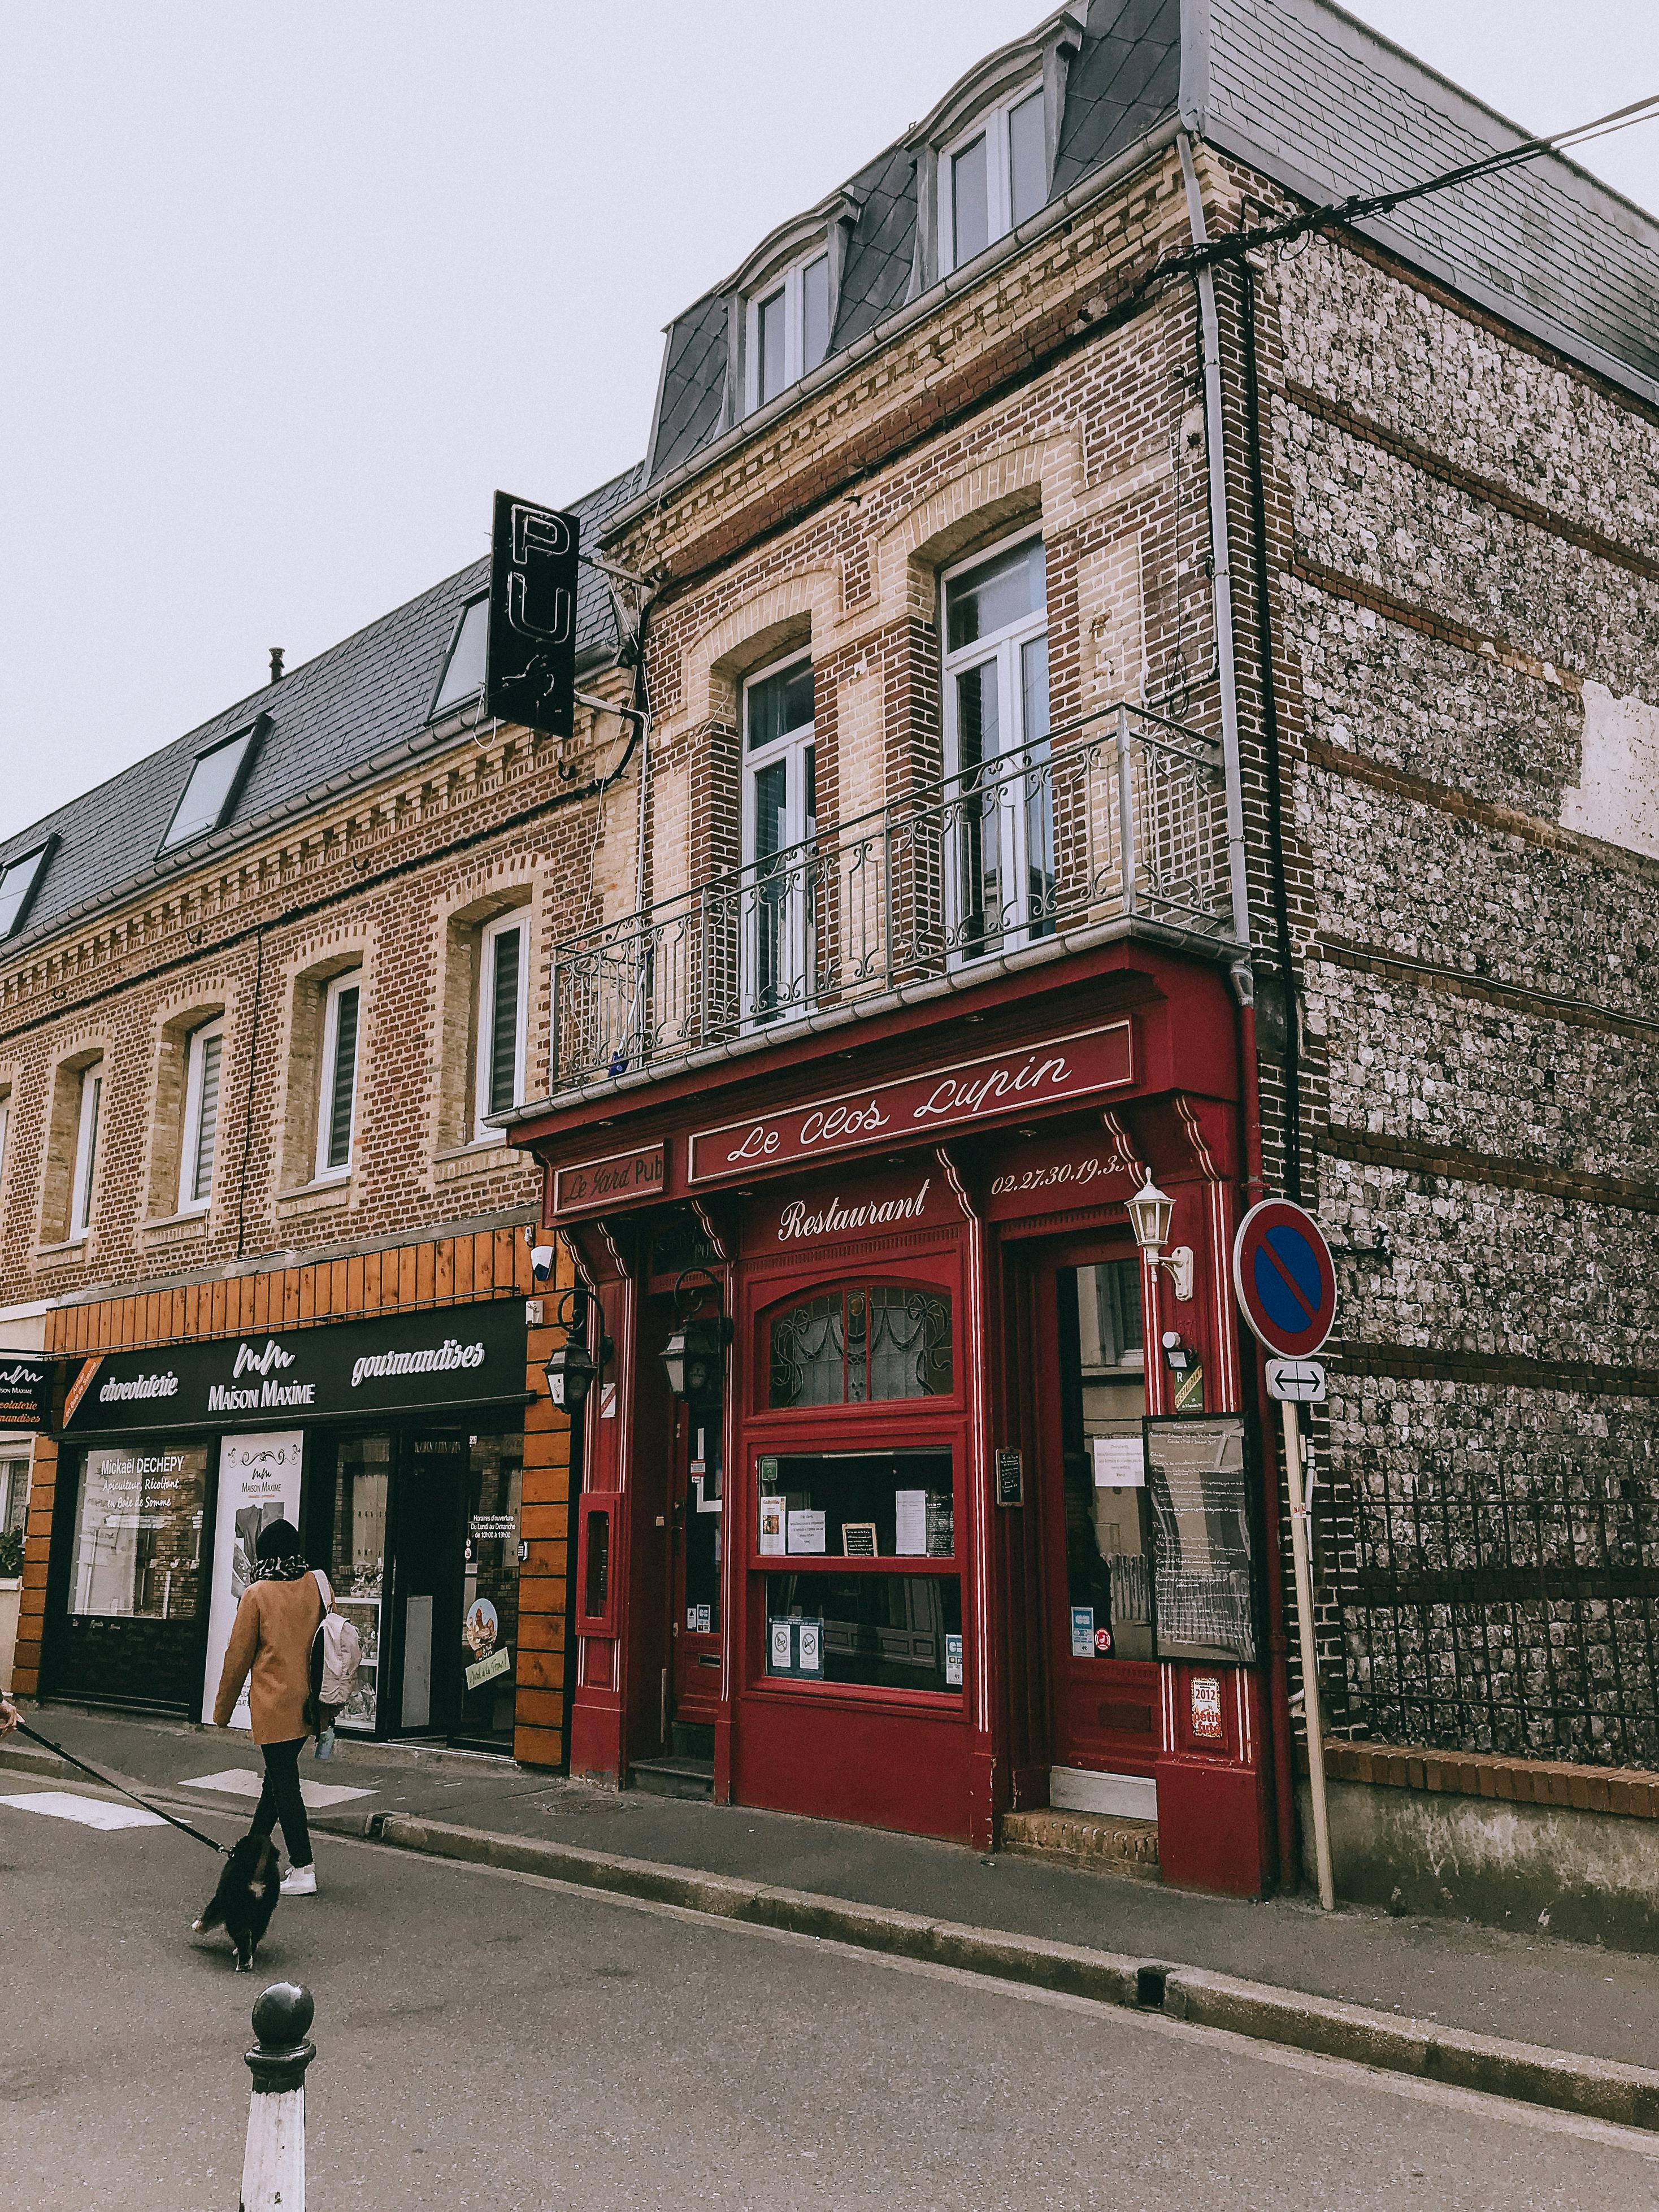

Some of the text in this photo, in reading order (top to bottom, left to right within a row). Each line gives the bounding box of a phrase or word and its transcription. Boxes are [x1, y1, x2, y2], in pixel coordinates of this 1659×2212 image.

[504, 504, 571, 696] PU
[727, 1055, 1072, 1162] Le Clos Lupin
[564, 1175, 587, 1203] Le
[635, 1155, 663, 1184] Pub
[778, 1179, 930, 1241] Restaurant
[100, 1371, 178, 1402] chocolaterie
[351, 1339, 485, 1387] gourmandises
[101, 1456, 184, 1475] Mickaël DECHEPY
[145, 1496, 172, 1508] Somme
[1196, 1688, 1215, 1701] 2012
